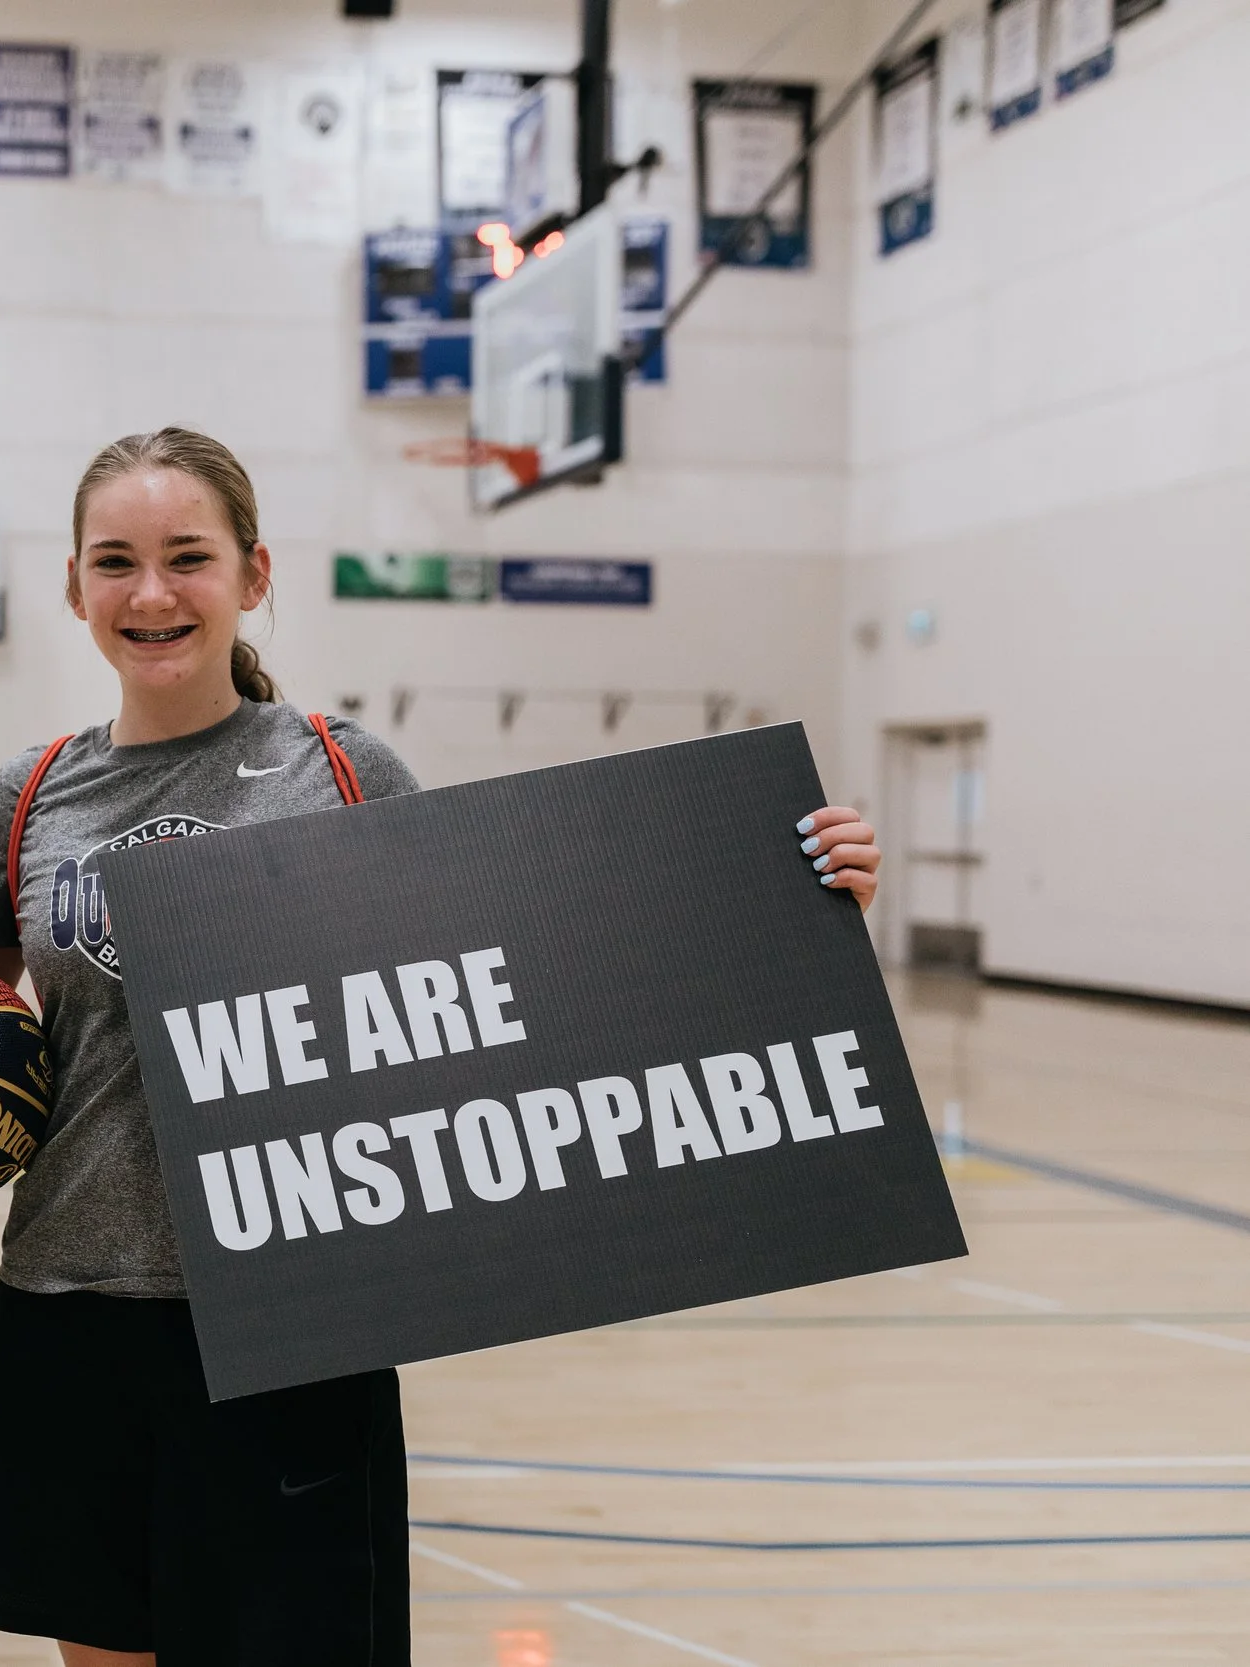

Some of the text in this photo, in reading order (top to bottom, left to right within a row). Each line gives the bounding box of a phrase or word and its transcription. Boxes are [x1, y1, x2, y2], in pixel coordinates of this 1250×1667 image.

[109, 821, 214, 852] CALGAR
[162, 947, 526, 1103] WE ARE
[198, 1030, 884, 1250] UNSTOPPABLE
